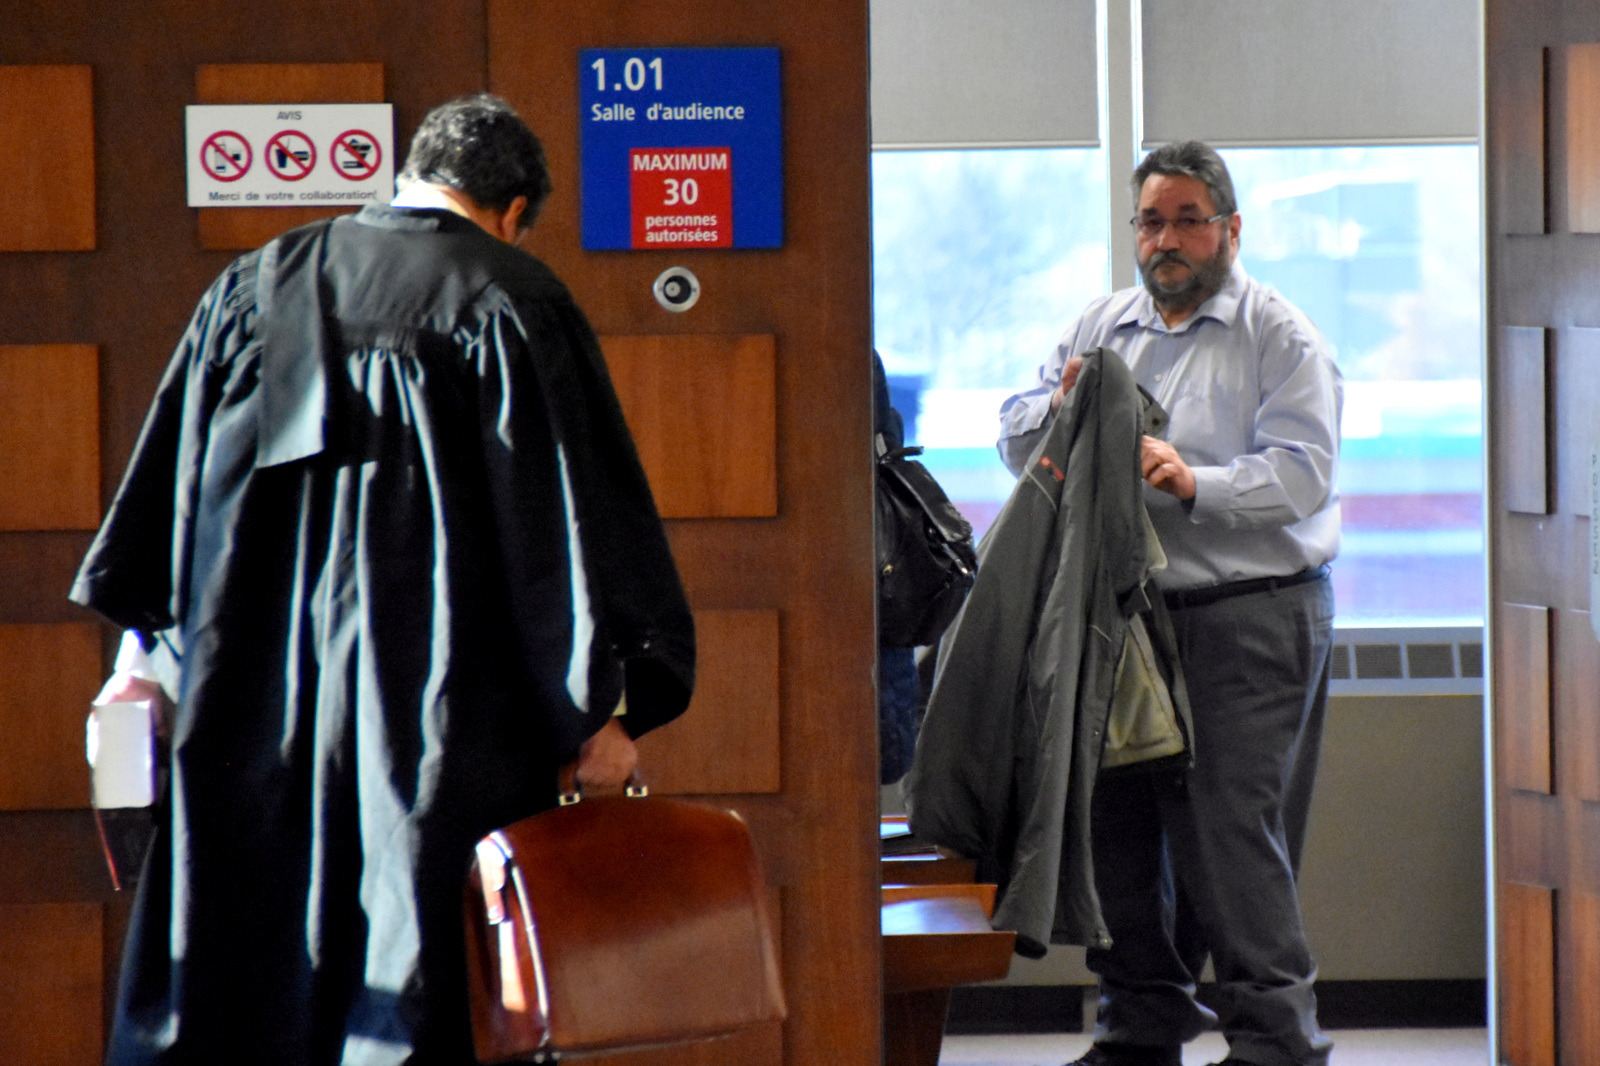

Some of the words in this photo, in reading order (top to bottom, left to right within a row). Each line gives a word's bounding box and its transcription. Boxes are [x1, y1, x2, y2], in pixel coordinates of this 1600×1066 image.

[591, 57, 663, 91] 1.01
[277, 111, 302, 120] AVIS
[591, 103, 636, 121] Salle
[646, 102, 745, 120] d'audience
[633, 153, 727, 171] MAXIMUM
[209, 192, 240, 201] Merci
[245, 192, 260, 200] de
[265, 192, 294, 200] votre
[300, 190, 377, 200] collaboration!
[663, 178, 698, 206] 30
[645, 215, 717, 230] personnes
[646, 229, 718, 242] autorisées
